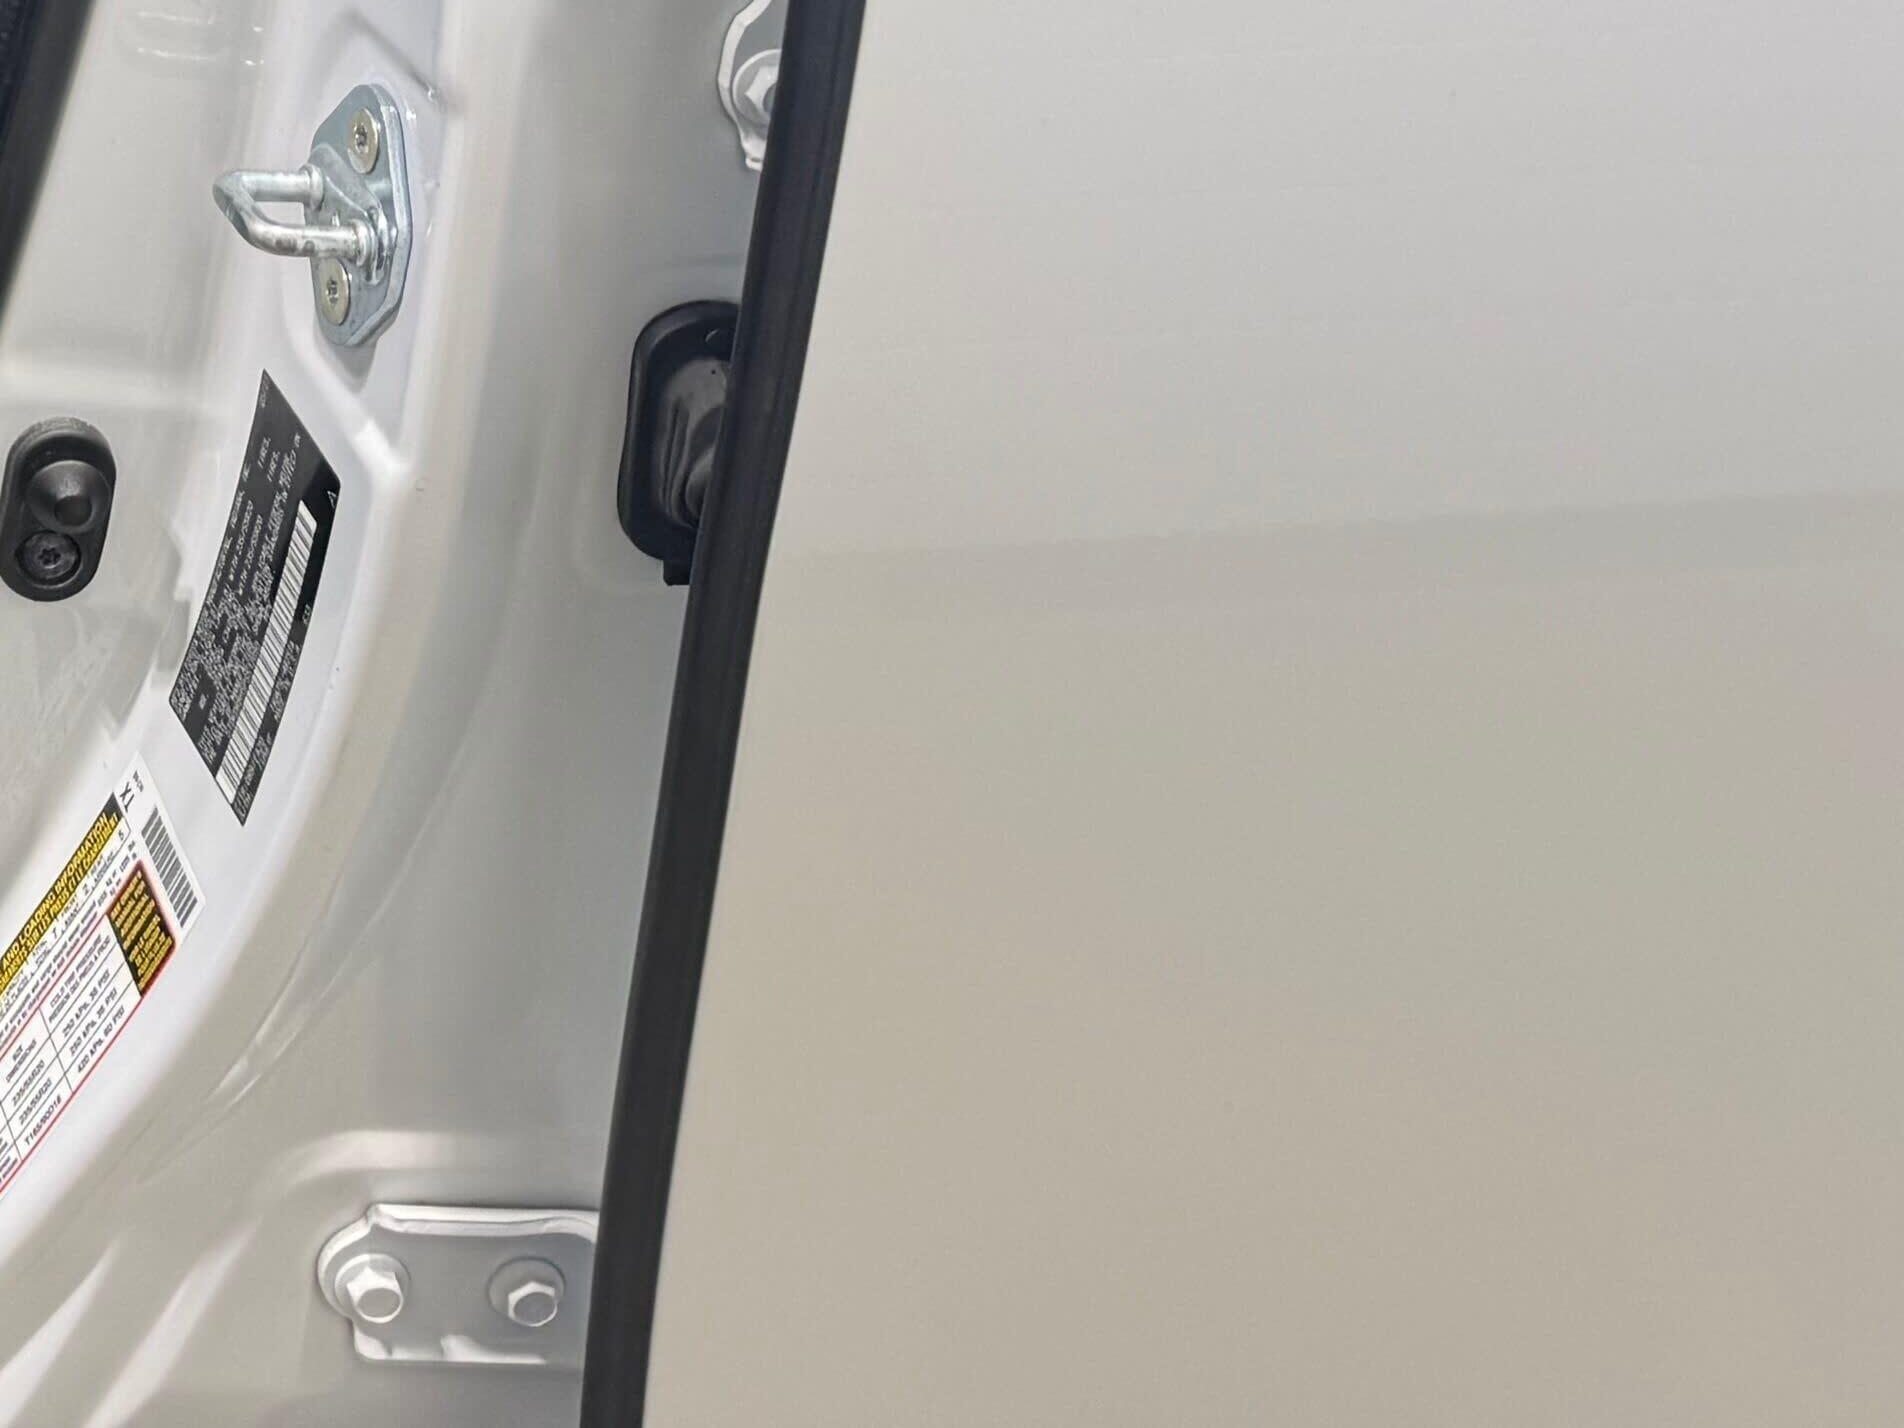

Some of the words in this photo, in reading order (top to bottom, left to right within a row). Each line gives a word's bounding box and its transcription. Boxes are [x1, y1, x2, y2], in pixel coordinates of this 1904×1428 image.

[120, 782, 134, 811] TX
[2, 940, 18, 970] AND
[20, 890, 53, 945] LOADING
[55, 812, 106, 894] INFORMATION
